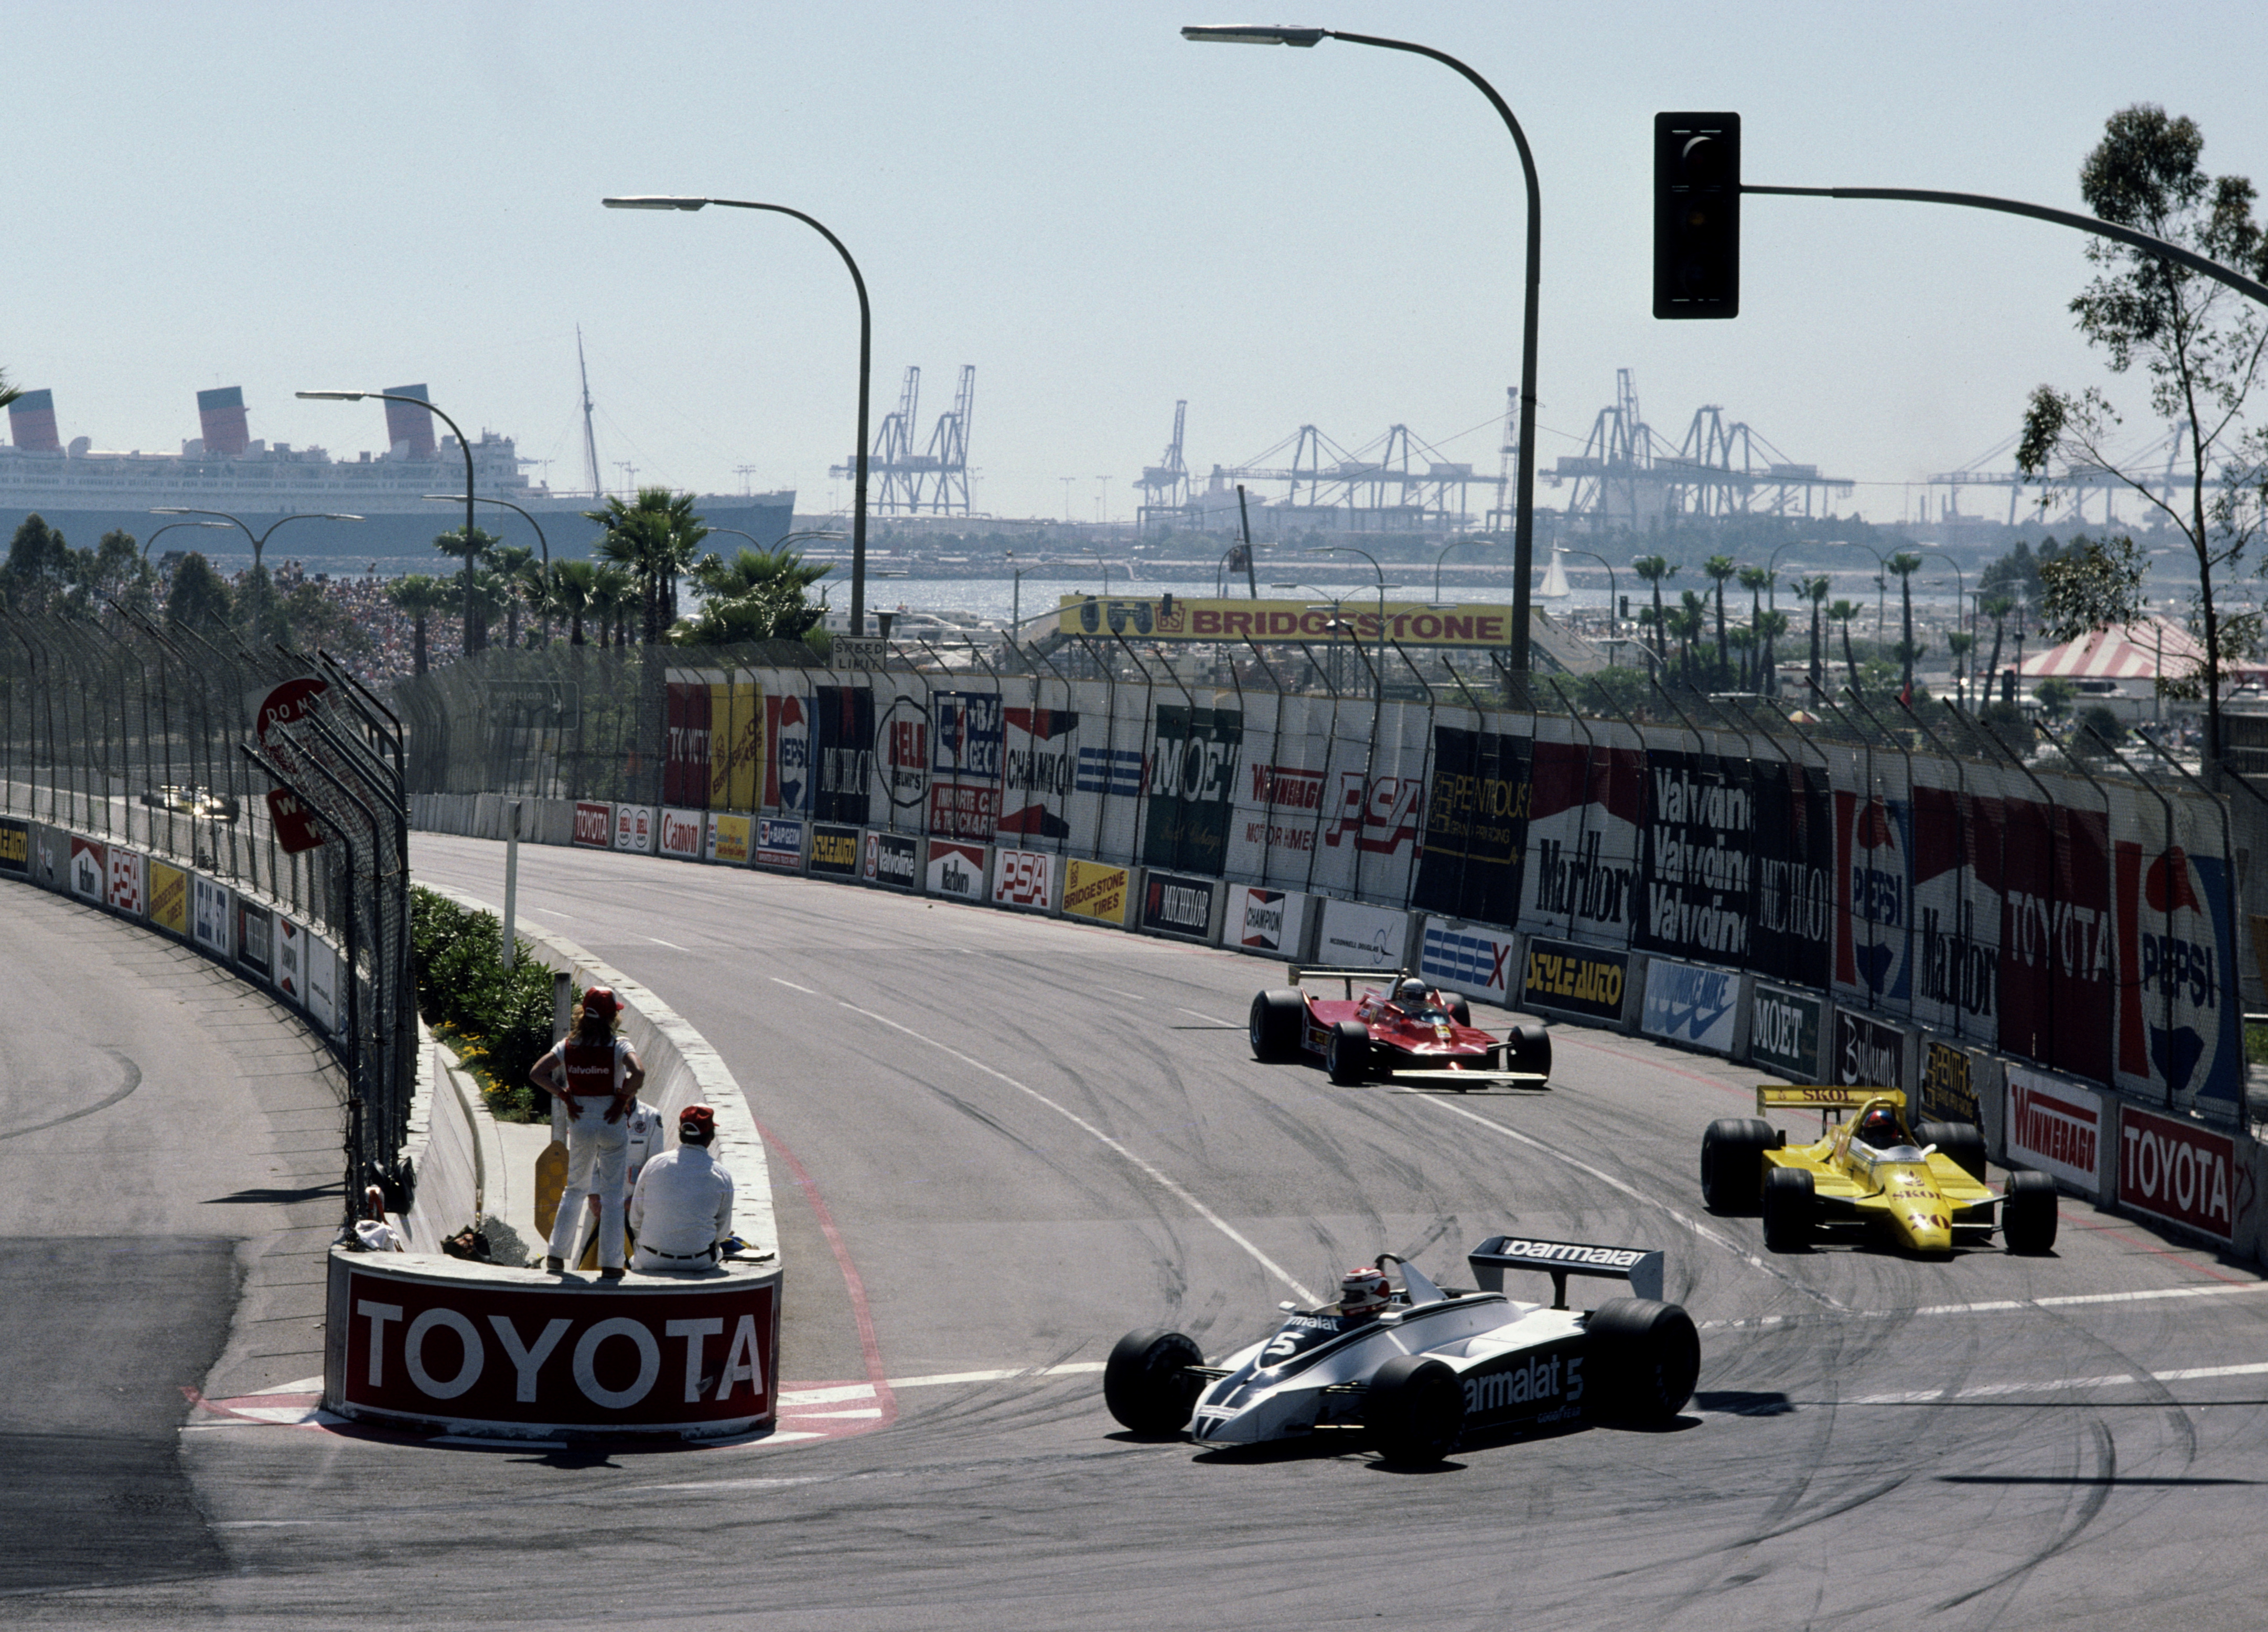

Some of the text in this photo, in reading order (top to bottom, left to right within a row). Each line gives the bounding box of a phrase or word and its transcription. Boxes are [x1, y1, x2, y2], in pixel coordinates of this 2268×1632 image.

[1192, 610, 1504, 640] BRIDGESTONE
[835, 643, 884, 654] SPEED
[839, 658, 877, 669] LIMIT
[266, 703, 291, 722] DO
[576, 810, 607, 840] TOYOTA
[619, 817, 648, 834] BELL BELL
[1325, 771, 1426, 860] PSA
[663, 813, 698, 853] Canon
[878, 845, 914, 877] Valvoline
[941, 860, 969, 894] Marlboro
[110, 849, 142, 913] PSA
[996, 852, 1047, 907] PSA
[1063, 871, 1125, 910] BRIDGESTONE
[1854, 866, 1902, 926] PEPSI
[1093, 892, 1120, 917] TIRES
[1161, 884, 1208, 928] MICHELOB
[1246, 907, 1281, 932] CHAMPION
[1358, 942, 1379, 953] DOUGLAS
[2007, 889, 2109, 982] TOYOTA
[1921, 899, 1997, 1016] Marlbor
[2143, 932, 2214, 1008] PEPSI
[1754, 995, 1803, 1059] MOËT
[567, 1064, 610, 1075] Valvoline
[1802, 1089, 1854, 1101] SKOL
[2012, 1084, 2098, 1173] WINNEBAGO
[2124, 1125, 2229, 1223] TOYOTA
[1907, 1214, 1950, 1231] 20
[1283, 1315, 1340, 1332] rmalat
[357, 1298, 764, 1409] TOYOTA
[1264, 1332, 1306, 1356] 5
[1463, 1354, 1584, 1414] armalat 5
